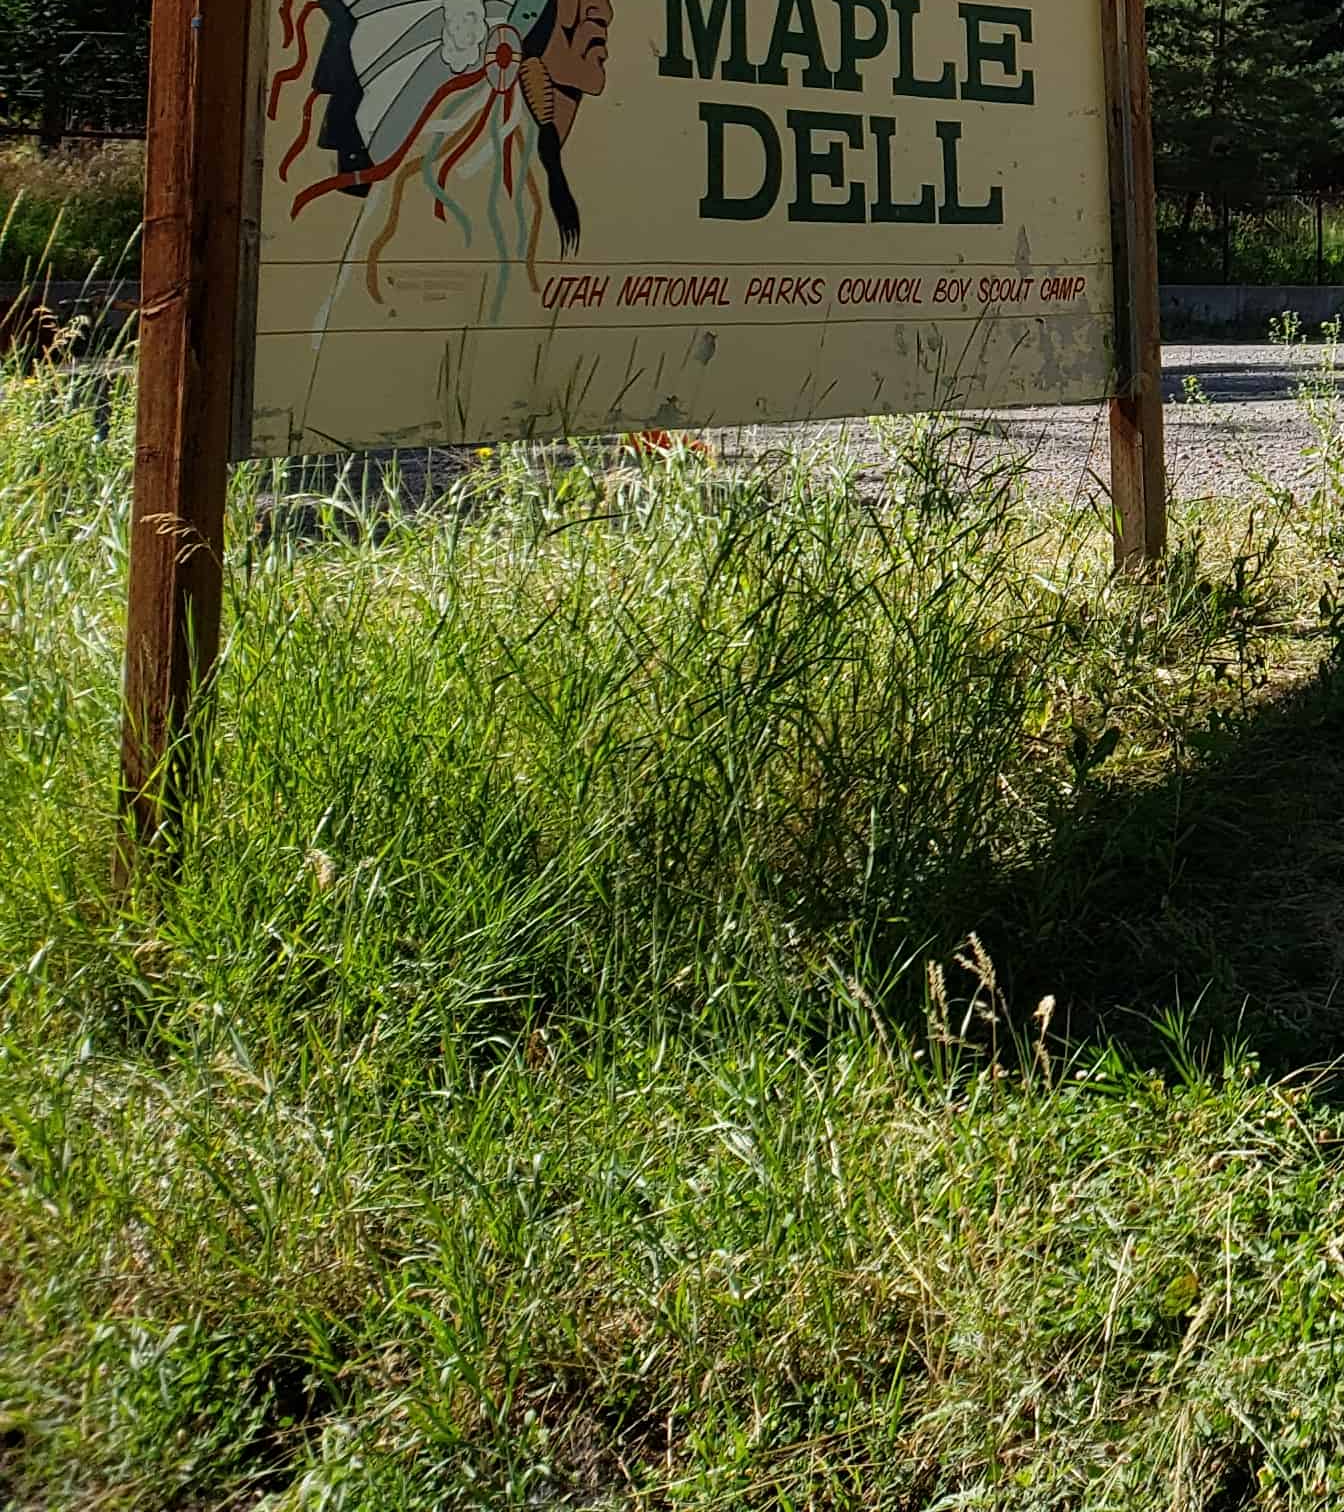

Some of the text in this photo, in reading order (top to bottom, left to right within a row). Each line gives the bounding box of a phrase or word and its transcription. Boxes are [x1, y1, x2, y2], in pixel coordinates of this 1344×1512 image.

[698, 101, 1004, 225] DELL
[541, 275, 610, 310] UTAH
[616, 276, 730, 307] NATIONAL
[744, 276, 826, 306] PARKS
[837, 277, 923, 304] COUNCIL
[932, 277, 973, 303] BOY
[976, 277, 1034, 303] SCOUT
